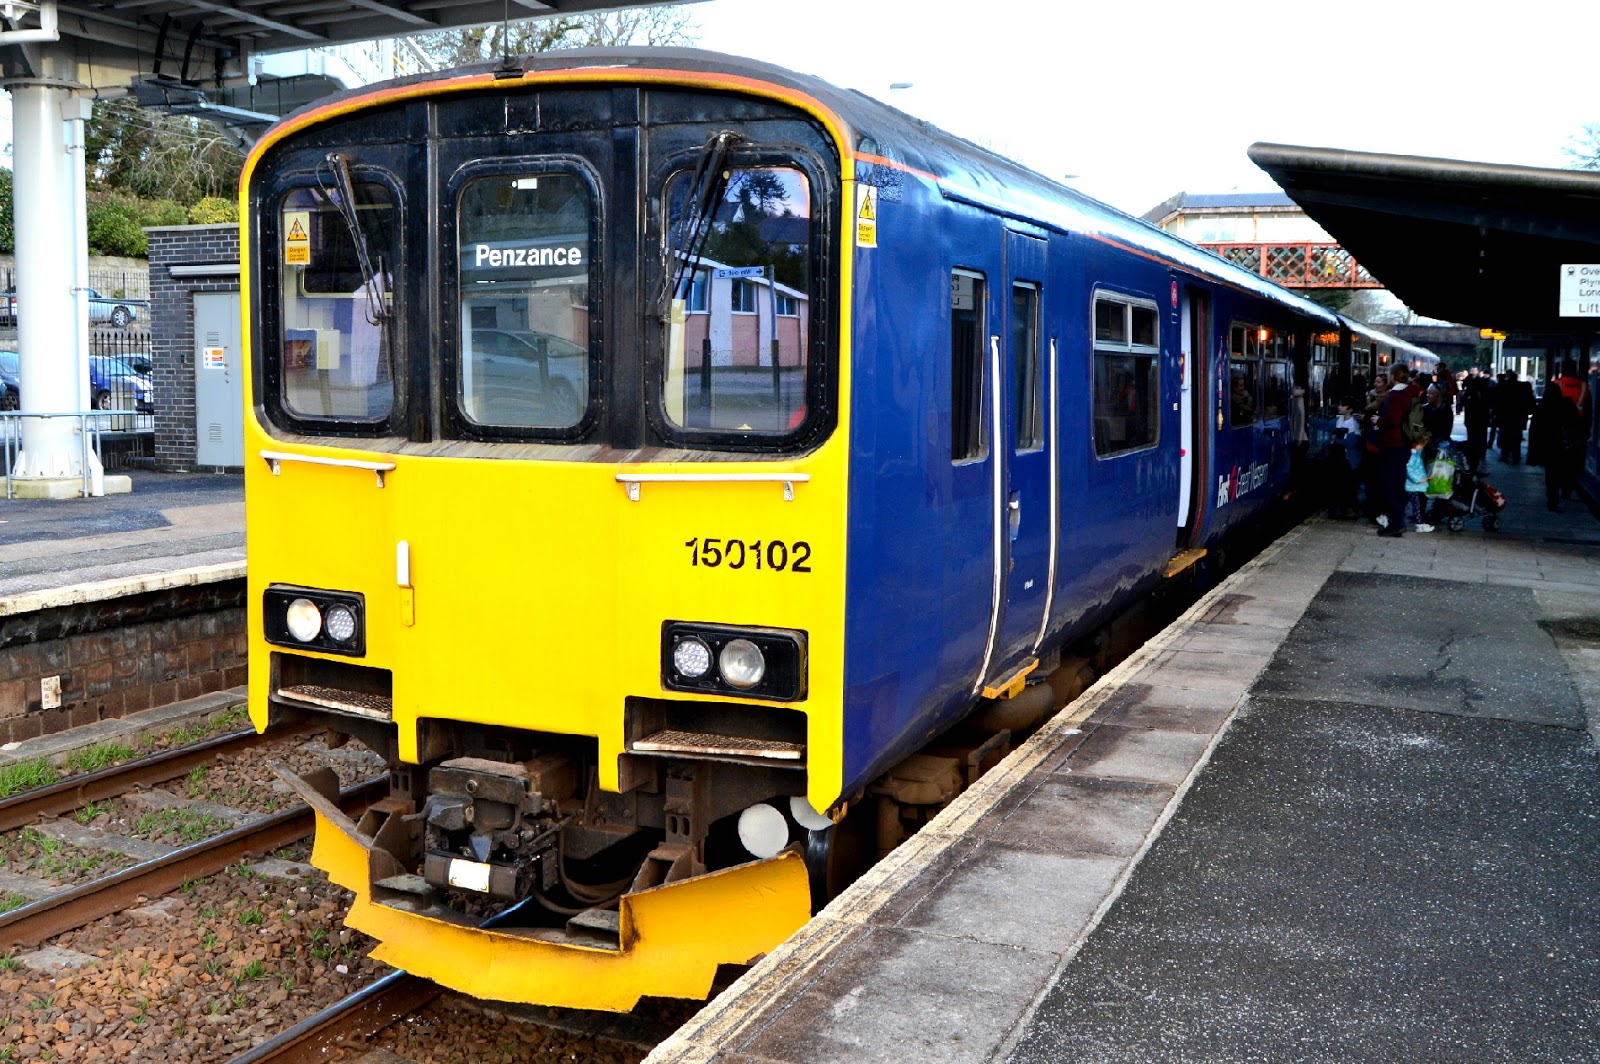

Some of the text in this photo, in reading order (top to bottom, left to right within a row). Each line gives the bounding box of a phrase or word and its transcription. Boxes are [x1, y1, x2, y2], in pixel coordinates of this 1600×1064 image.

[475, 244, 582, 267] Penzance
[1578, 303, 1599, 313] Lift
[685, 537, 812, 573] 150102
